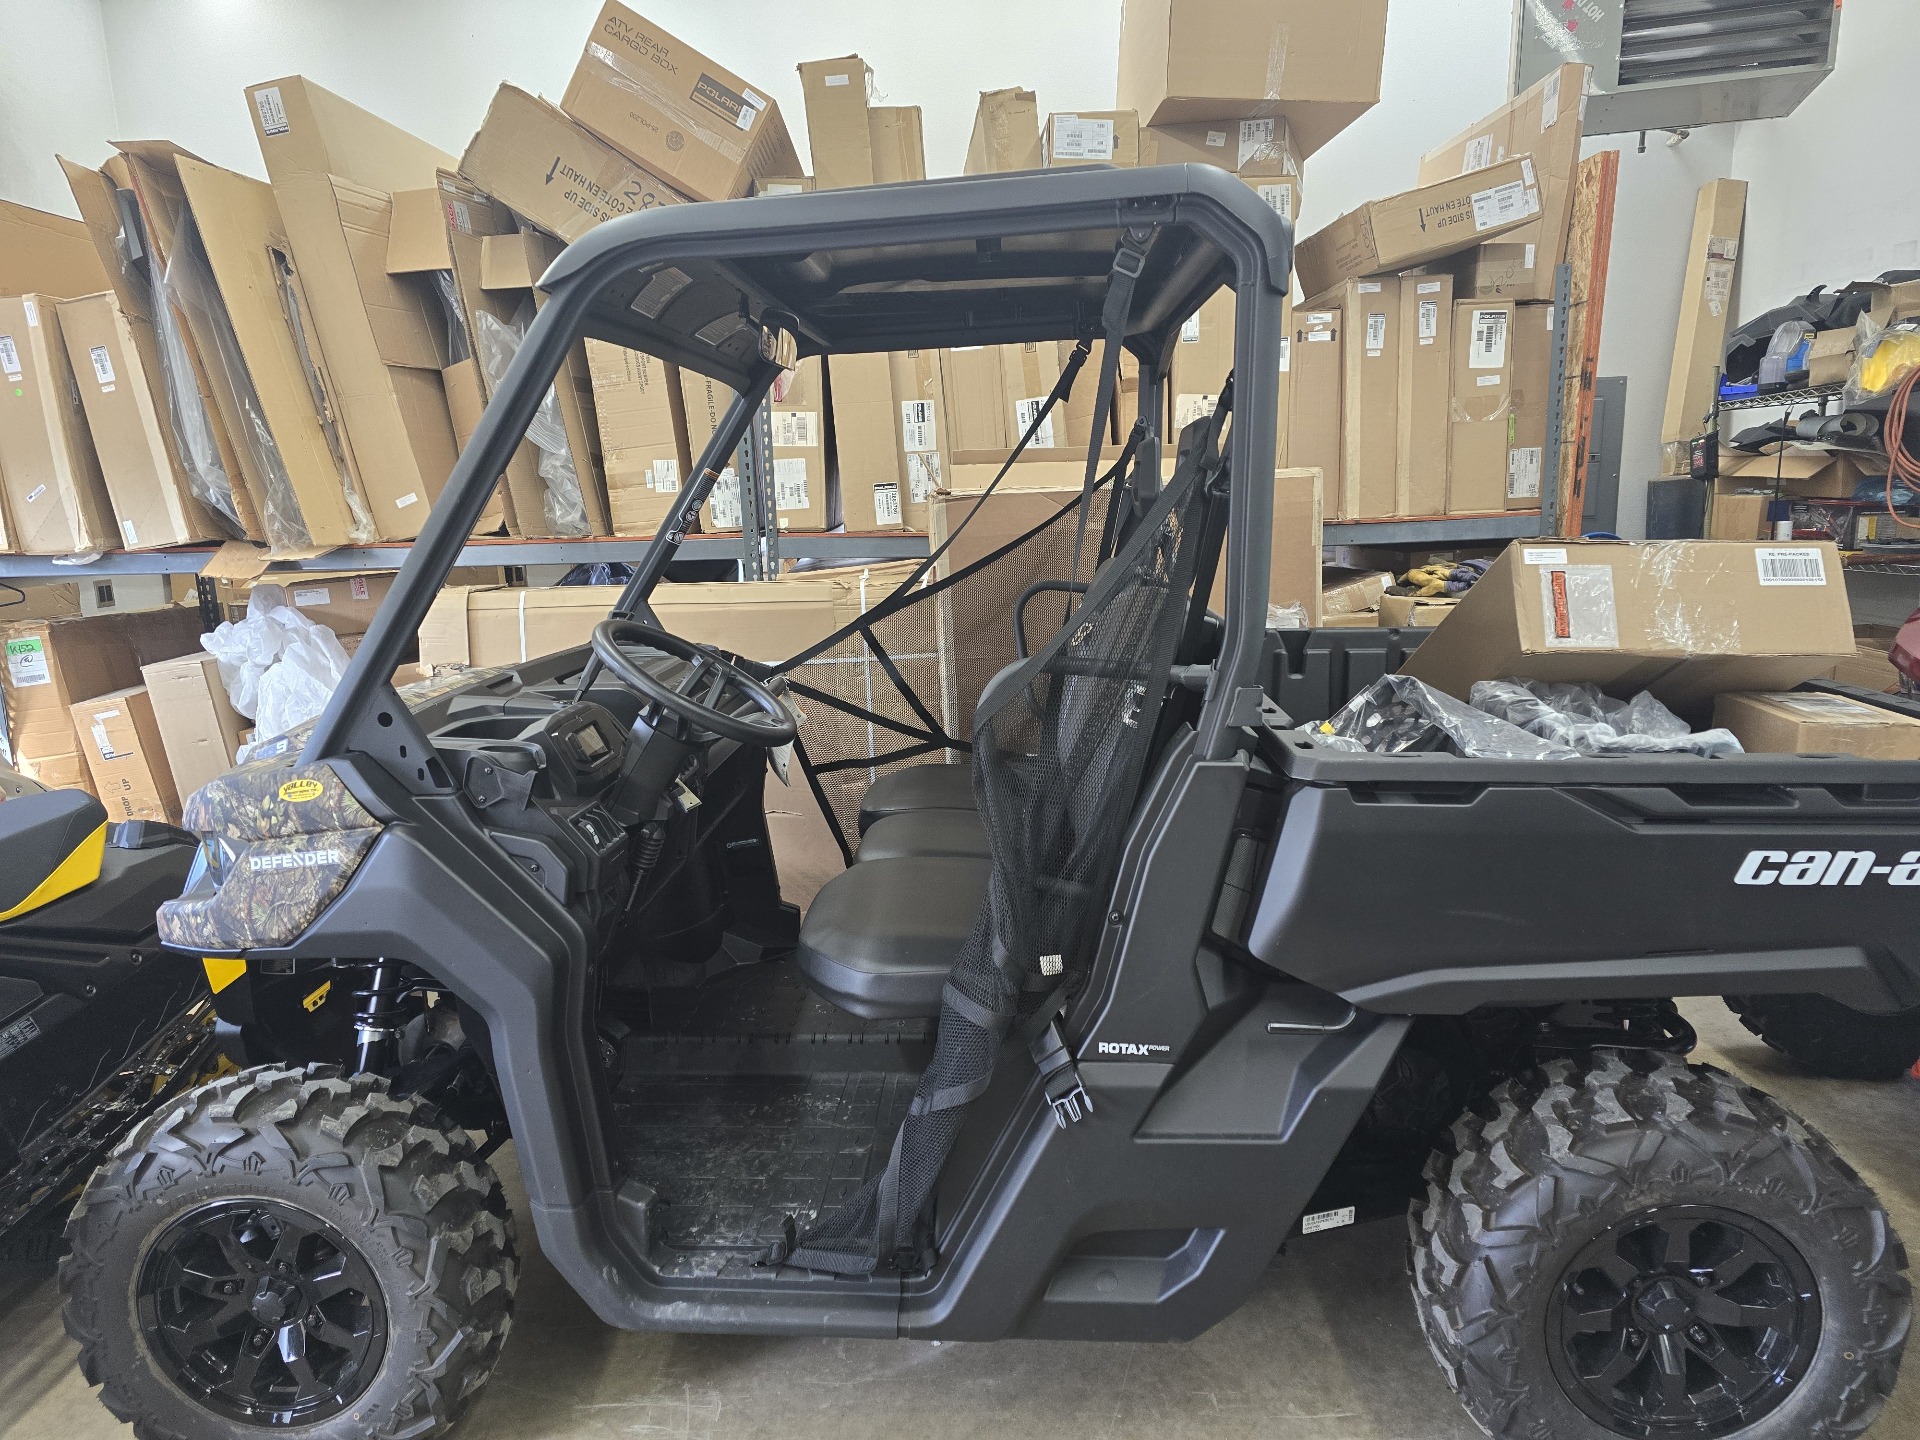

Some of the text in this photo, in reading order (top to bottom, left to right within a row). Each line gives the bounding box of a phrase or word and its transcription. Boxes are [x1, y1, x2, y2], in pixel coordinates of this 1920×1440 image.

[1582, 1, 1606, 22] HOT
[608, 16, 669, 57] ATV REAR
[604, 24, 679, 75] CARGO BOX
[697, 81, 742, 113] POLARI
[560, 164, 588, 188] HAUT
[563, 190, 578, 202] UP
[586, 181, 600, 197] EN
[577, 196, 600, 218] SIDE
[1425, 195, 1471, 217] ÔTÉ EN HAUT
[1437, 217, 1447, 228] UP
[1448, 212, 1466, 226] SIDE
[122, 778, 132, 791] UP
[122, 796, 134, 817] DROP
[251, 849, 341, 871] DEFENDER
[1733, 850, 1920, 886] can-a
[1098, 1042, 1170, 1055] ROTAX POWER
